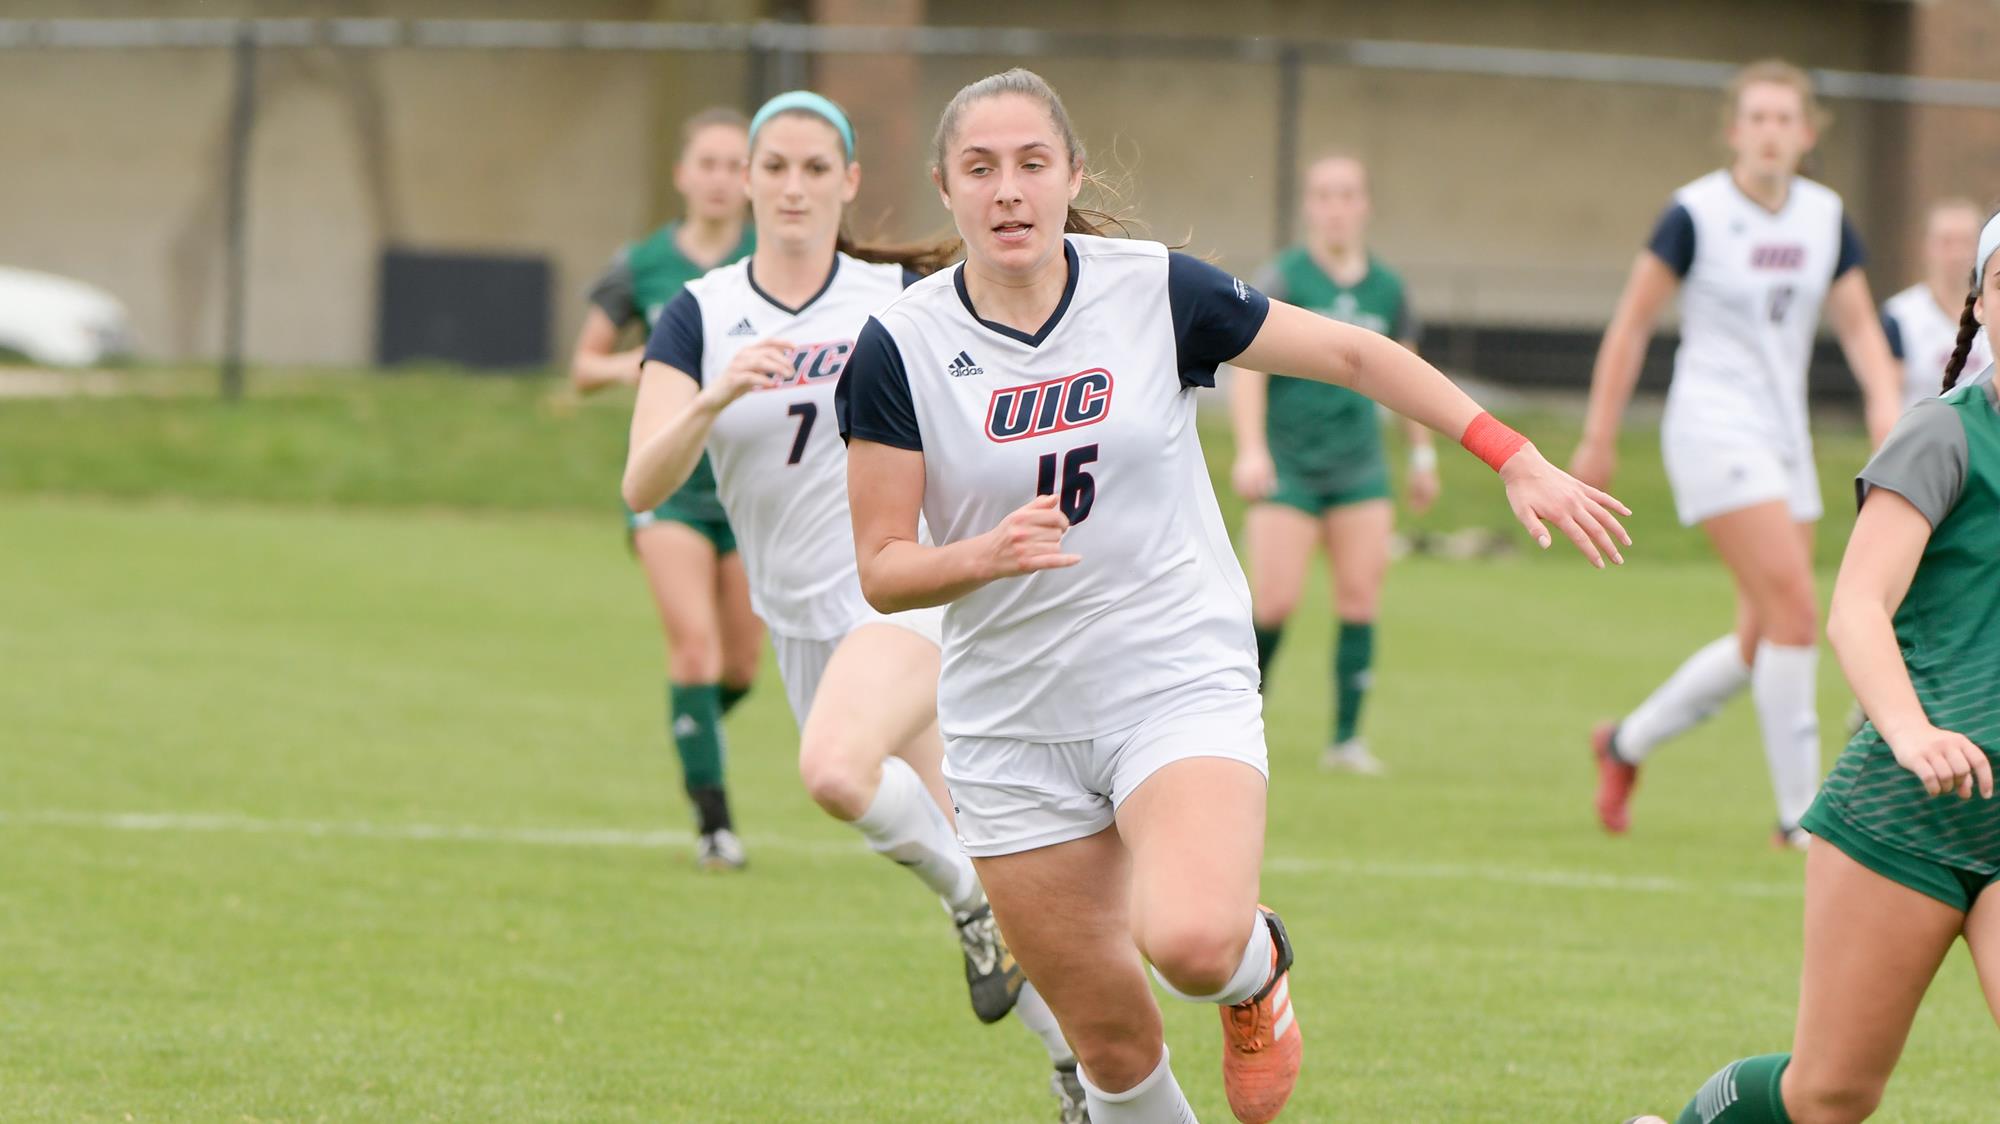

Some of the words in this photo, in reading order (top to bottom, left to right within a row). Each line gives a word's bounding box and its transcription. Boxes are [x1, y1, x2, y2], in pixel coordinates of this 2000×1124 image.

[767, 342, 851, 384] IC
[787, 402, 817, 465] 7
[988, 370, 1111, 440] UIC
[1037, 443, 1098, 526] 16
